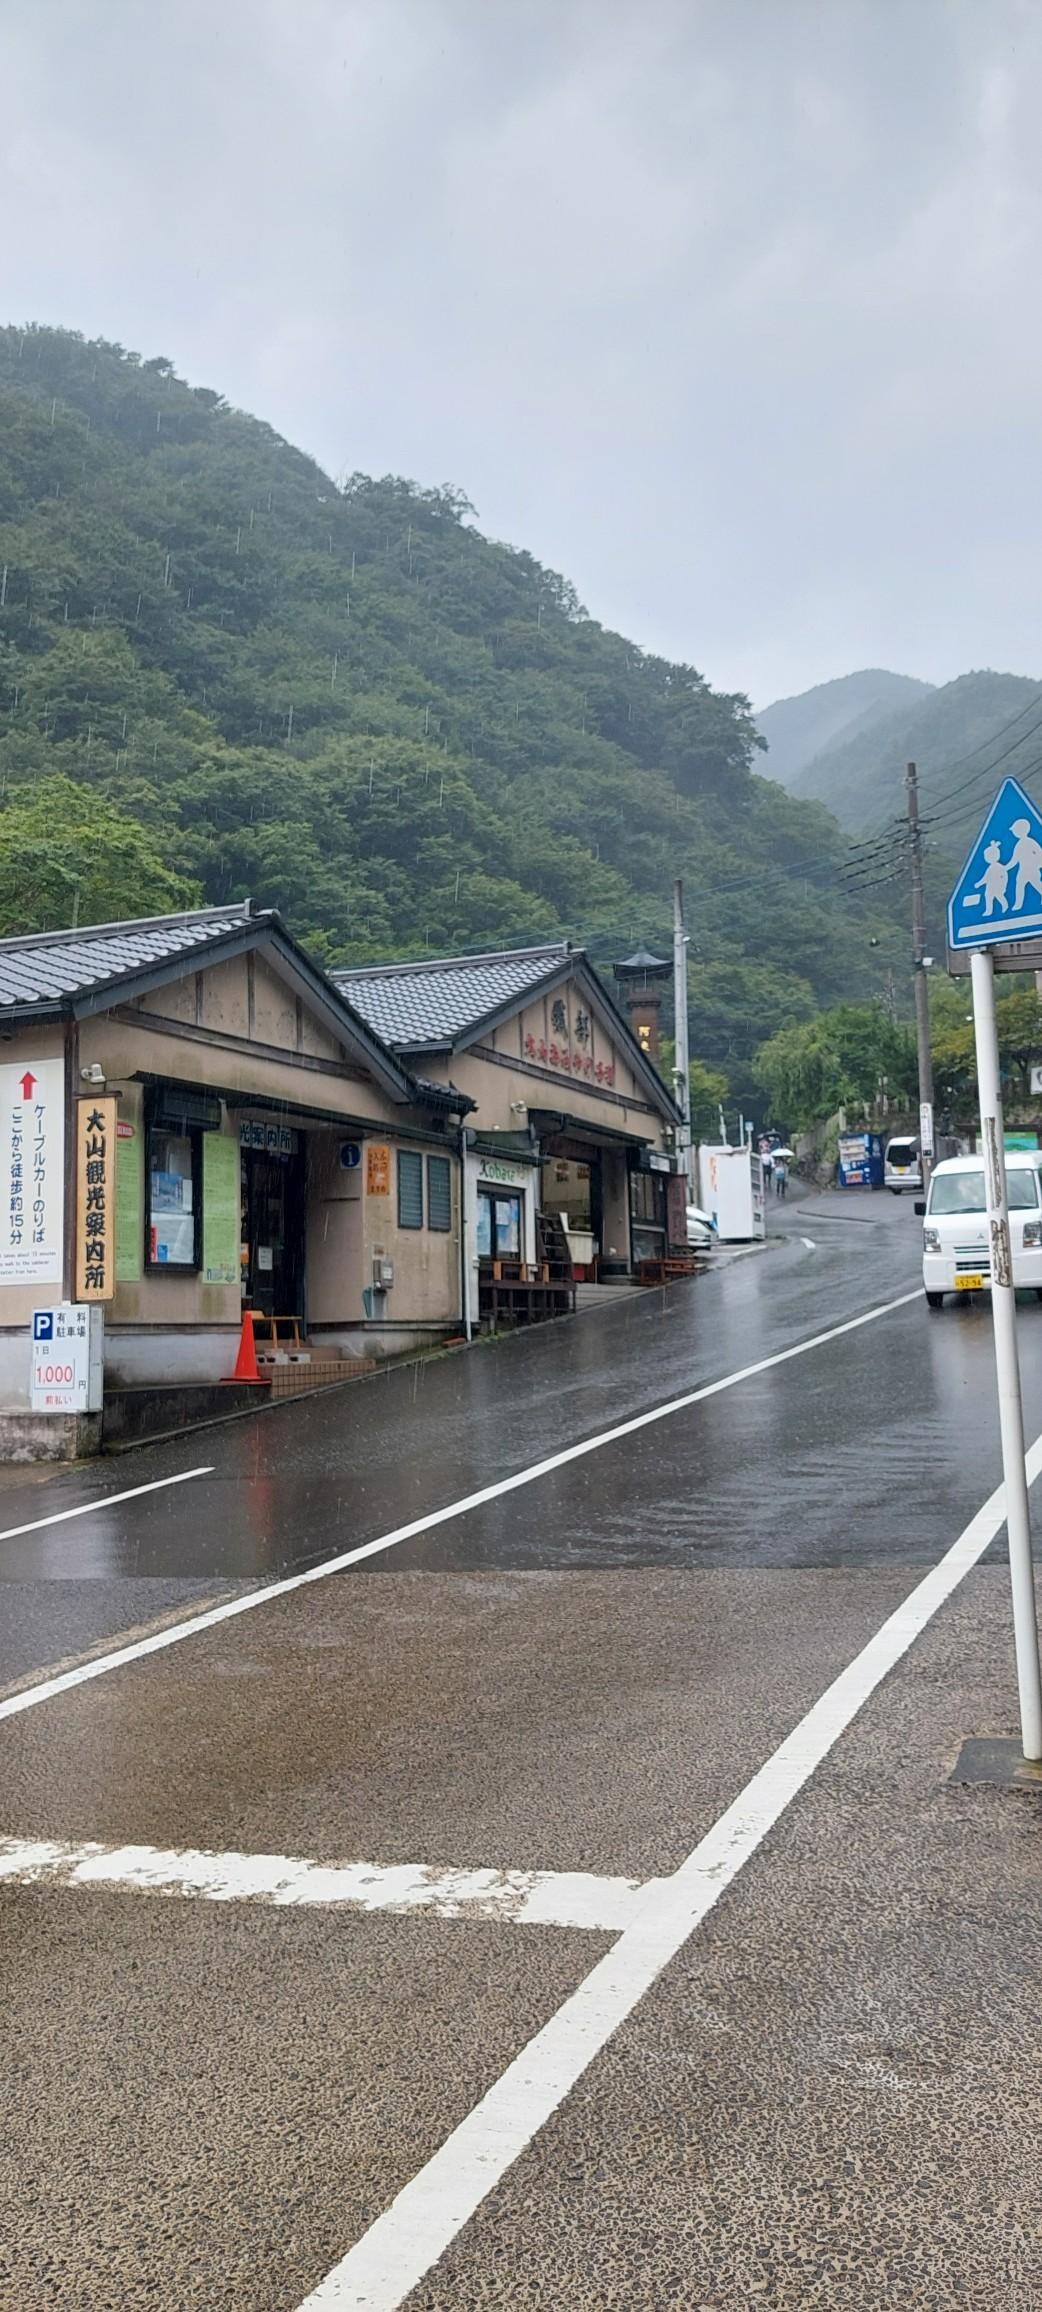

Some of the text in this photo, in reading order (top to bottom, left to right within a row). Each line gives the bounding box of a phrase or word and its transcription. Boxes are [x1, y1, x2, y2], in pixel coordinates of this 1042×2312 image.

[9, 1106, 24, 1245] ここから徒歩約15分
[32, 1103, 46, 1243] ケーブルカーのりば
[36, 1316, 51, 1337] P
[56, 1326, 86, 1338] 駐車場
[36, 1365, 86, 1389] 1,000 円
